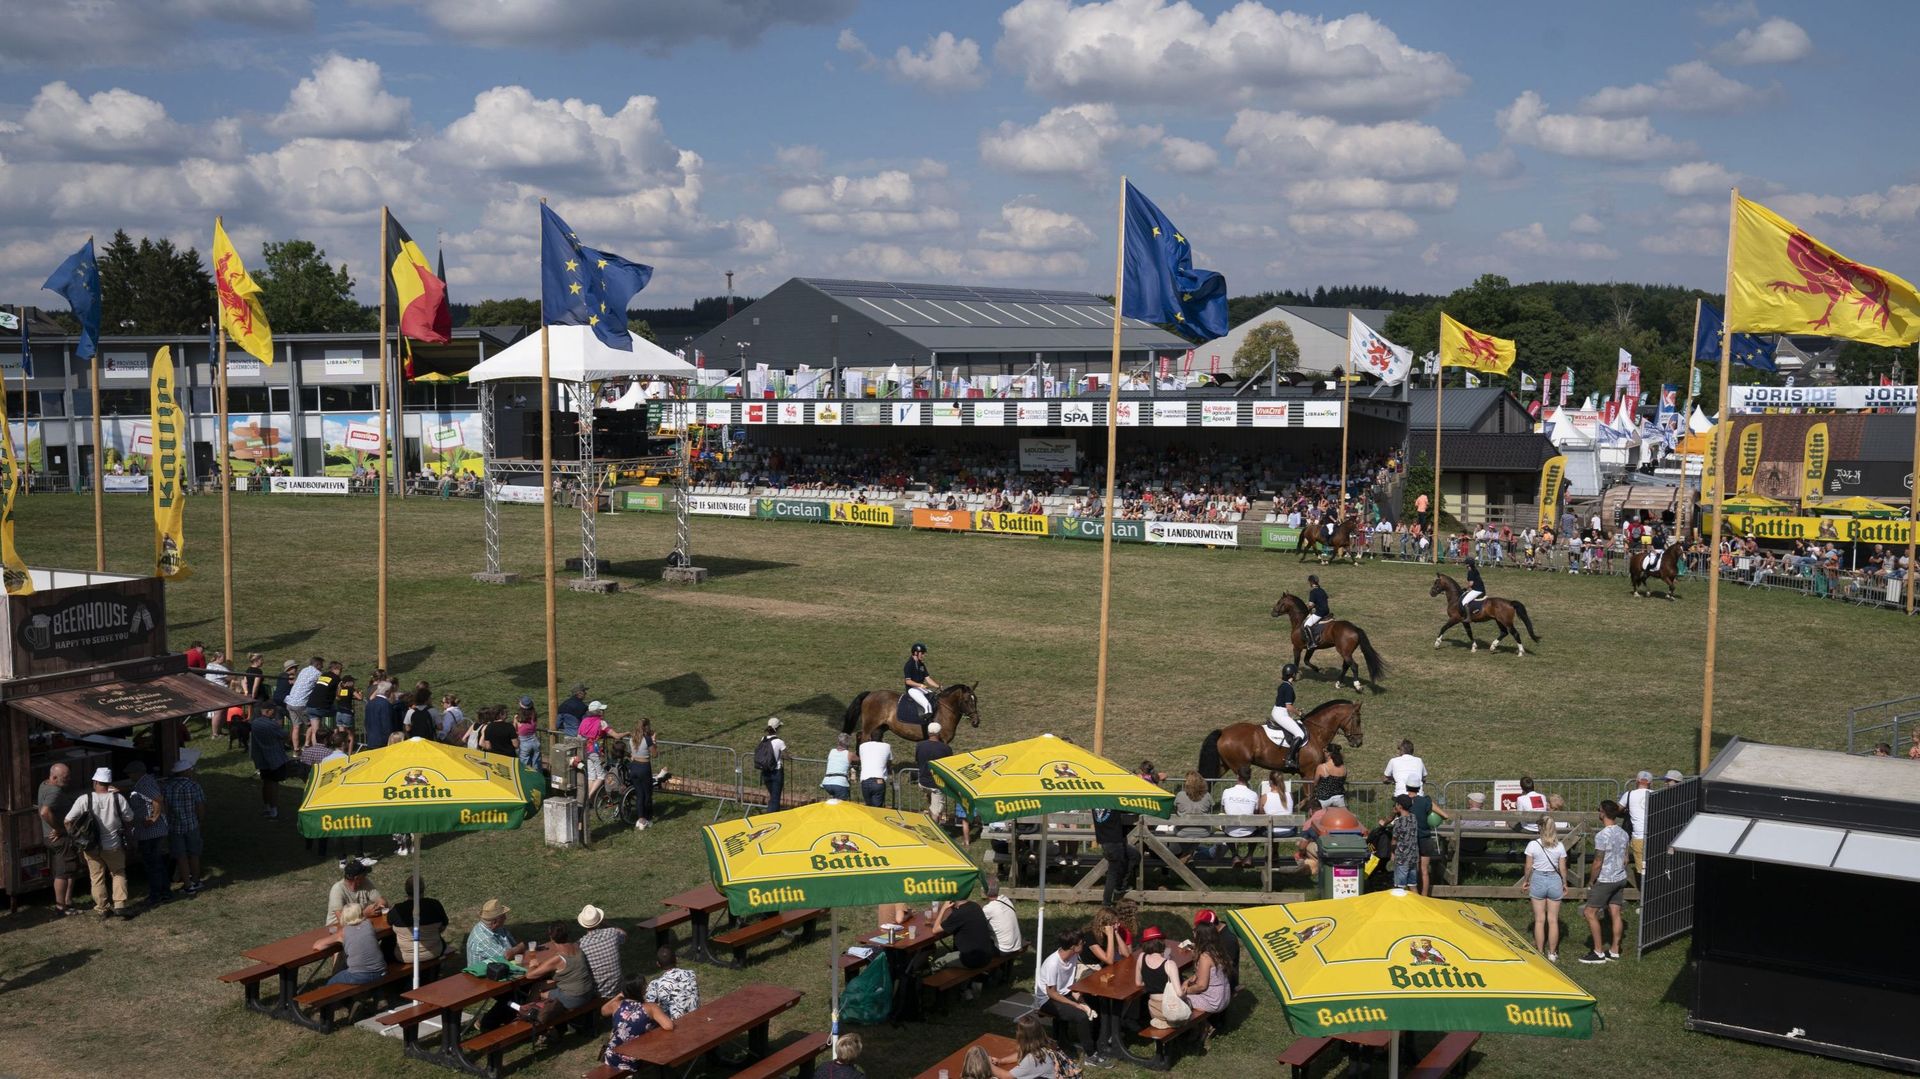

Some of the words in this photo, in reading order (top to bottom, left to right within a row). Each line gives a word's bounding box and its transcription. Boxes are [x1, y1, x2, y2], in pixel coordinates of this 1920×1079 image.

[1865, 387, 1918, 401] JORI
[1063, 413, 1089, 422] SPA
[1741, 432, 1758, 476] Battin
[1807, 432, 1824, 480] Battin
[289, 481, 345, 490] LANDBOUWLEVEN
[699, 501, 705, 509] LE
[776, 502, 821, 517] Crelan
[851, 505, 890, 522] Battin
[1000, 513, 1044, 532] Battin
[1081, 521, 1138, 537] Crlan
[1741, 516, 1804, 538] Battin
[1167, 528, 1234, 540] LANDBOUWLEVEN
[52, 602, 129, 636] BEERHOUSE
[55, 640, 80, 650] HAPPY
[82, 638, 92, 646] TO
[92, 635, 114, 644] SERVE
[115, 632, 129, 641] YOU
[383, 785, 452, 800] Battin
[1039, 777, 1105, 792] Battin
[994, 798, 1041, 816] Battin
[1118, 796, 1161, 812] Battin
[321, 813, 372, 832] Battin
[460, 808, 508, 825] Battin
[810, 853, 890, 870] Battin
[903, 876, 958, 895] Battin
[747, 886, 806, 907] Battin
[1388, 965, 1487, 990] Battin
[1316, 1003, 1388, 1028] Battin
[1505, 1003, 1573, 1028] Battin
